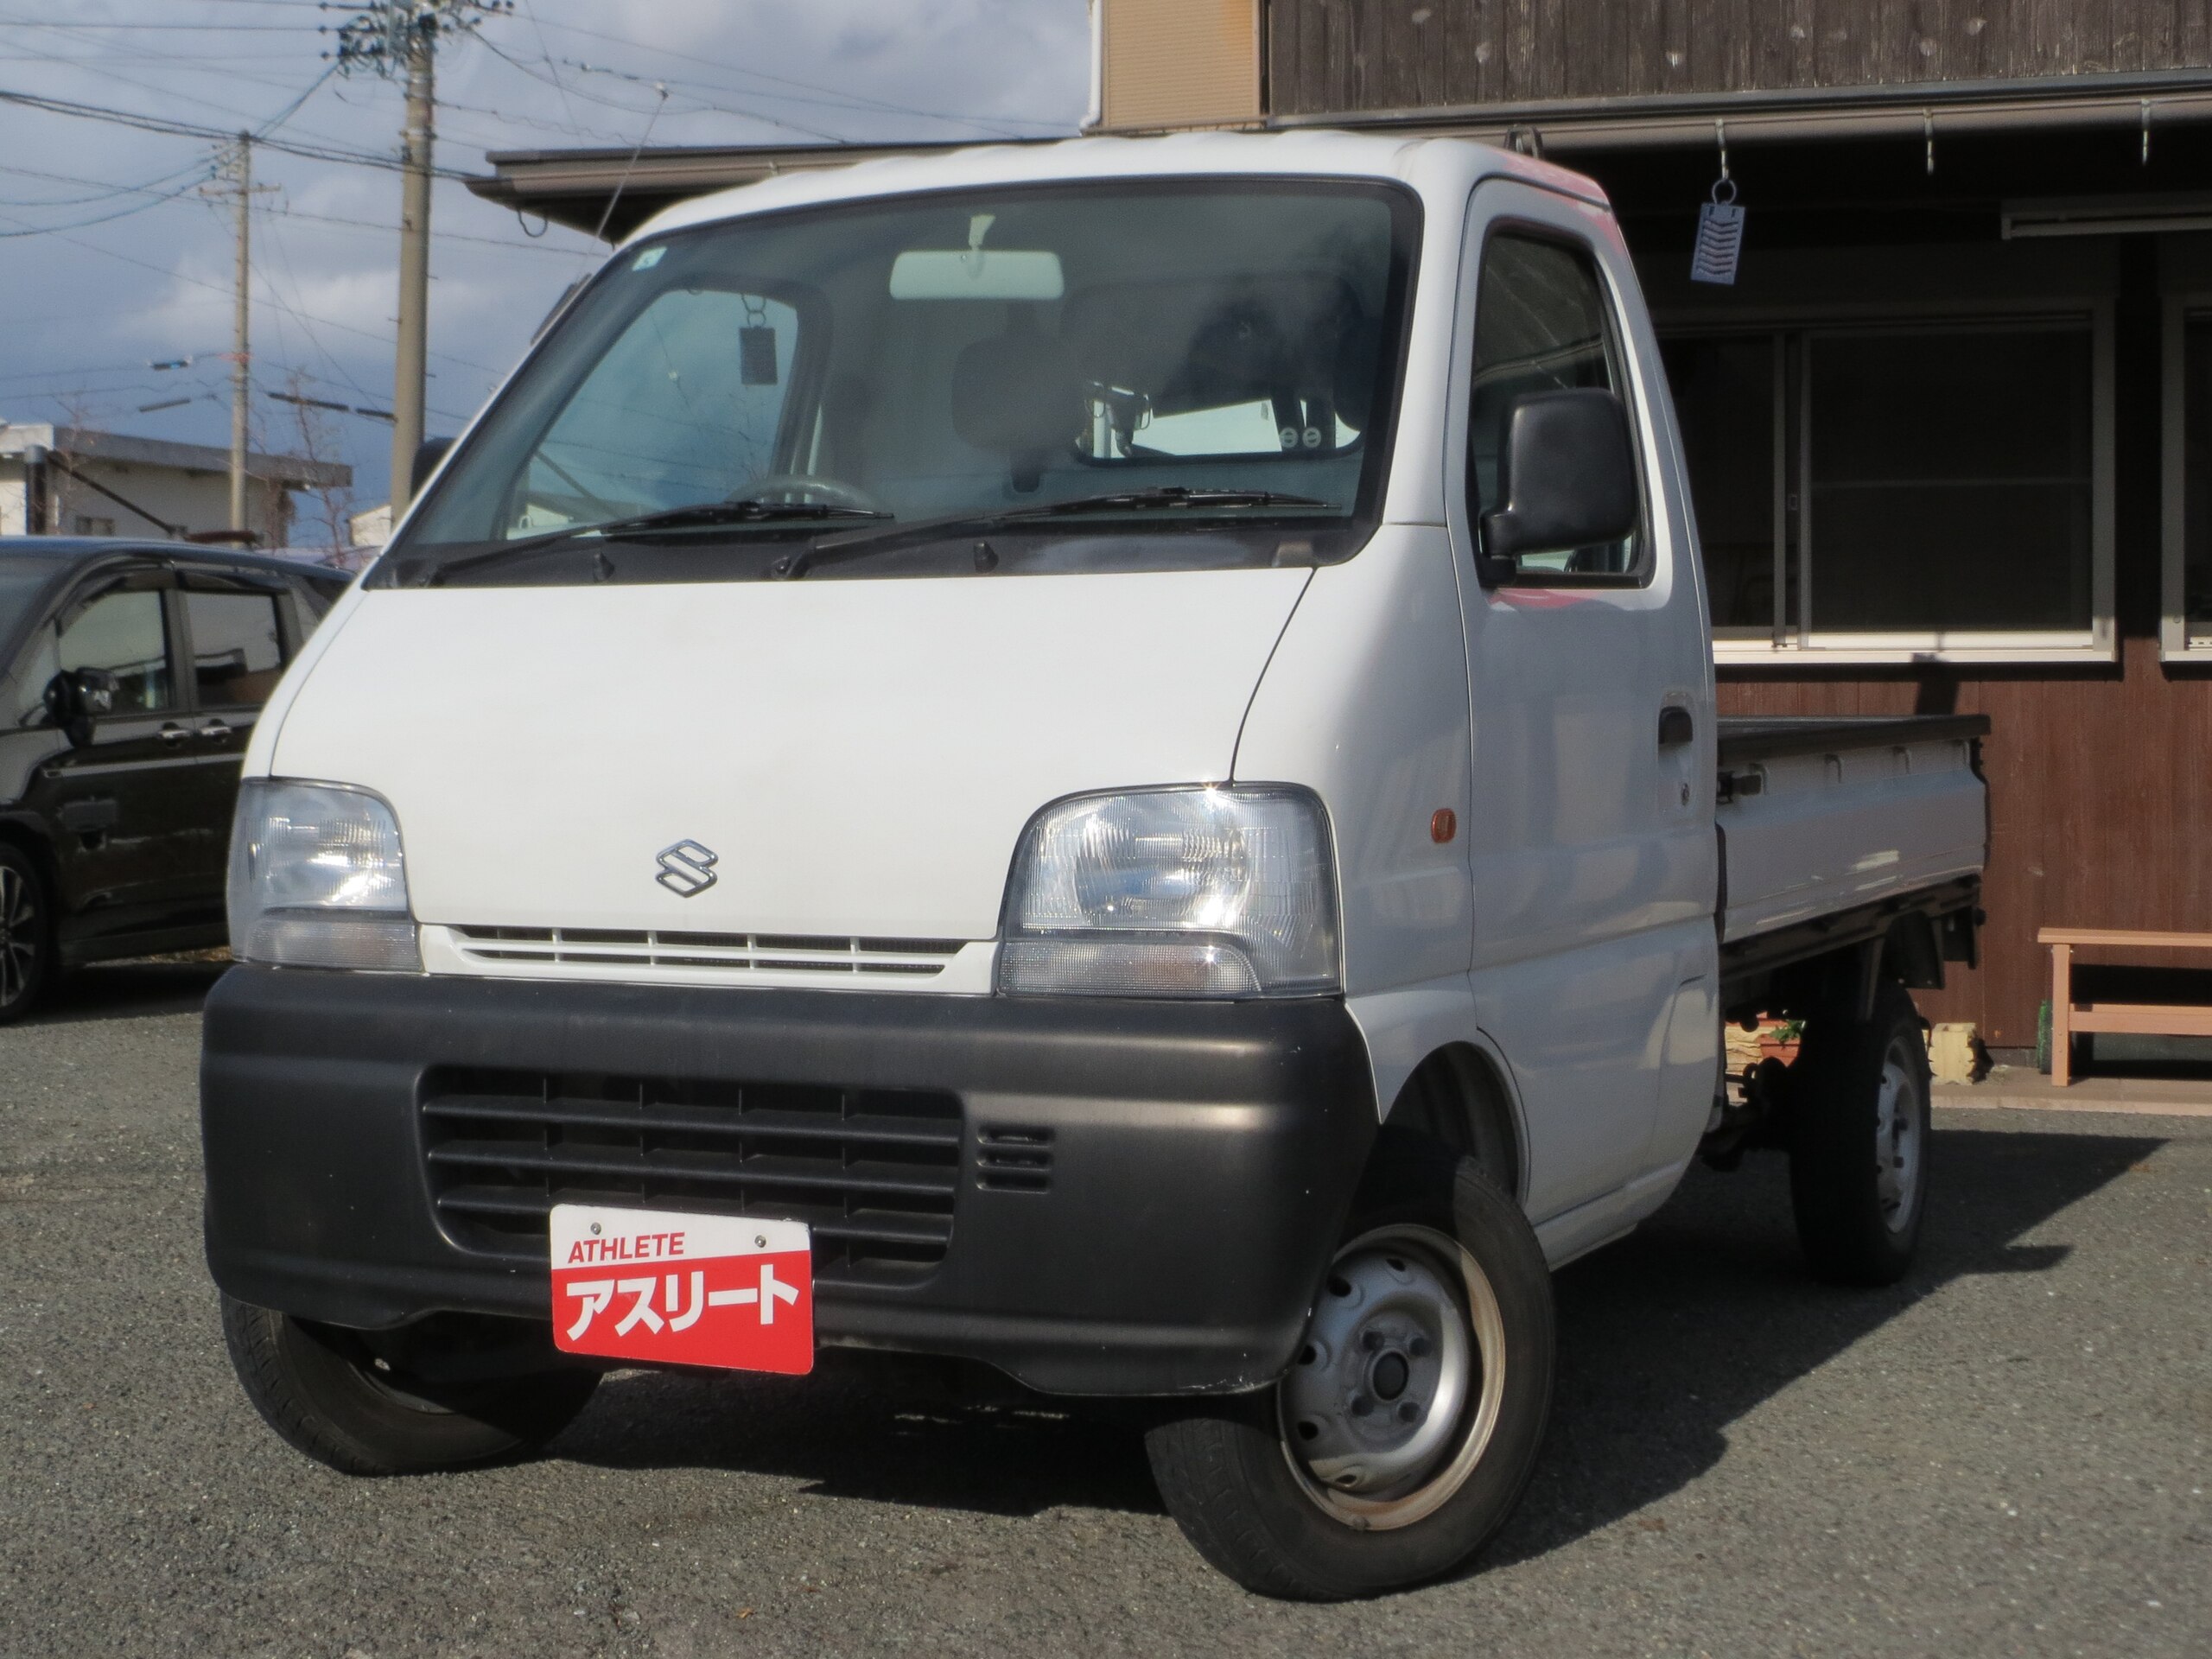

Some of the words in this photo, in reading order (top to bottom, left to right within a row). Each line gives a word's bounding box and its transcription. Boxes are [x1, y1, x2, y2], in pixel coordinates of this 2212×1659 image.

[568, 1232, 685, 1263] ATHLETE
[566, 1264, 799, 1341] アスリート
